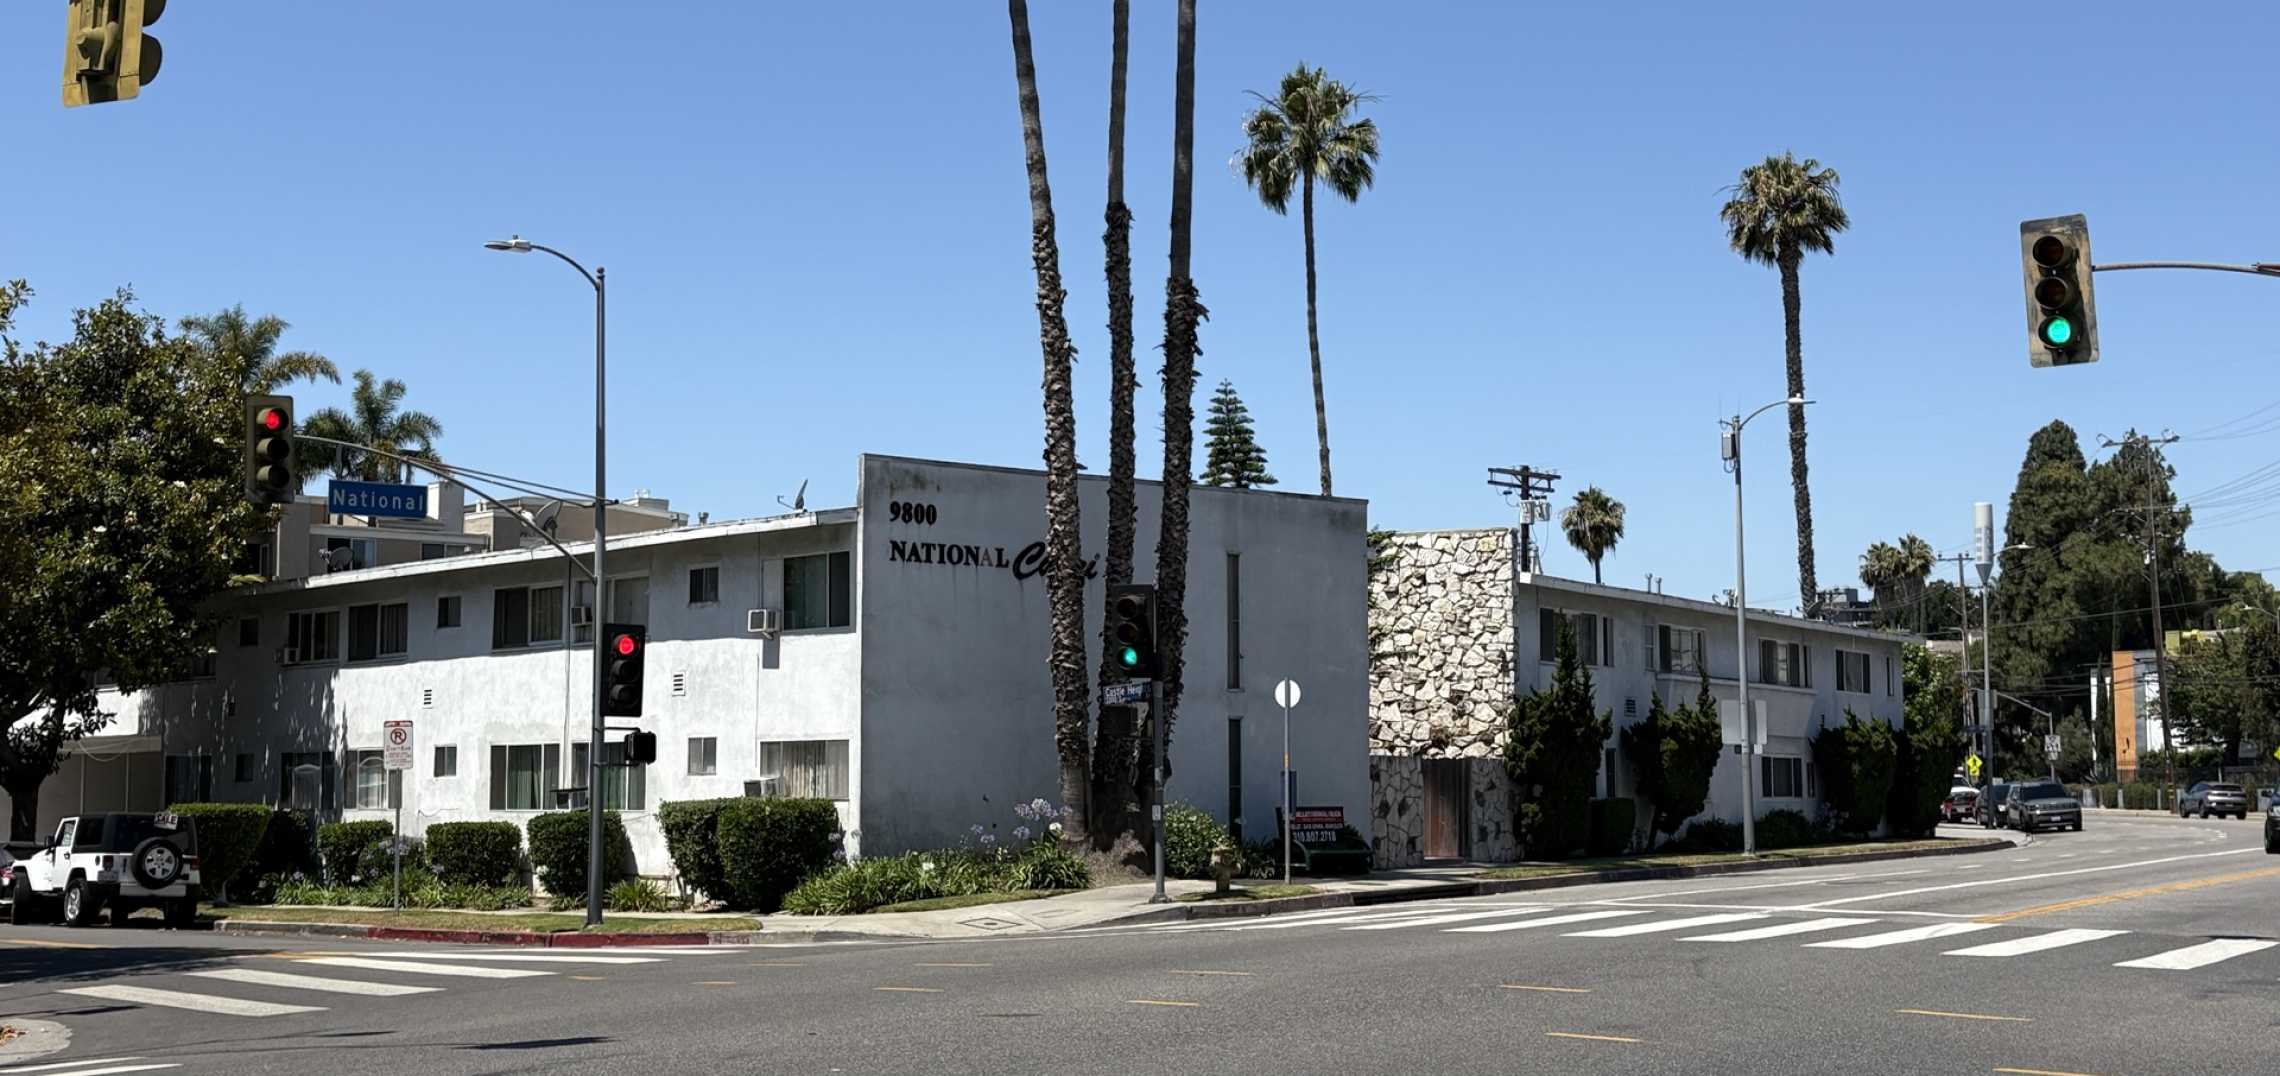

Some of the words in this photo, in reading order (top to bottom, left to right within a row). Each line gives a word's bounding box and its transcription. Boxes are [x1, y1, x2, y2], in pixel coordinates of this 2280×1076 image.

[333, 489, 423, 511] National
[889, 501, 937, 526] 9800
[889, 540, 1009, 568] NATIONAL
